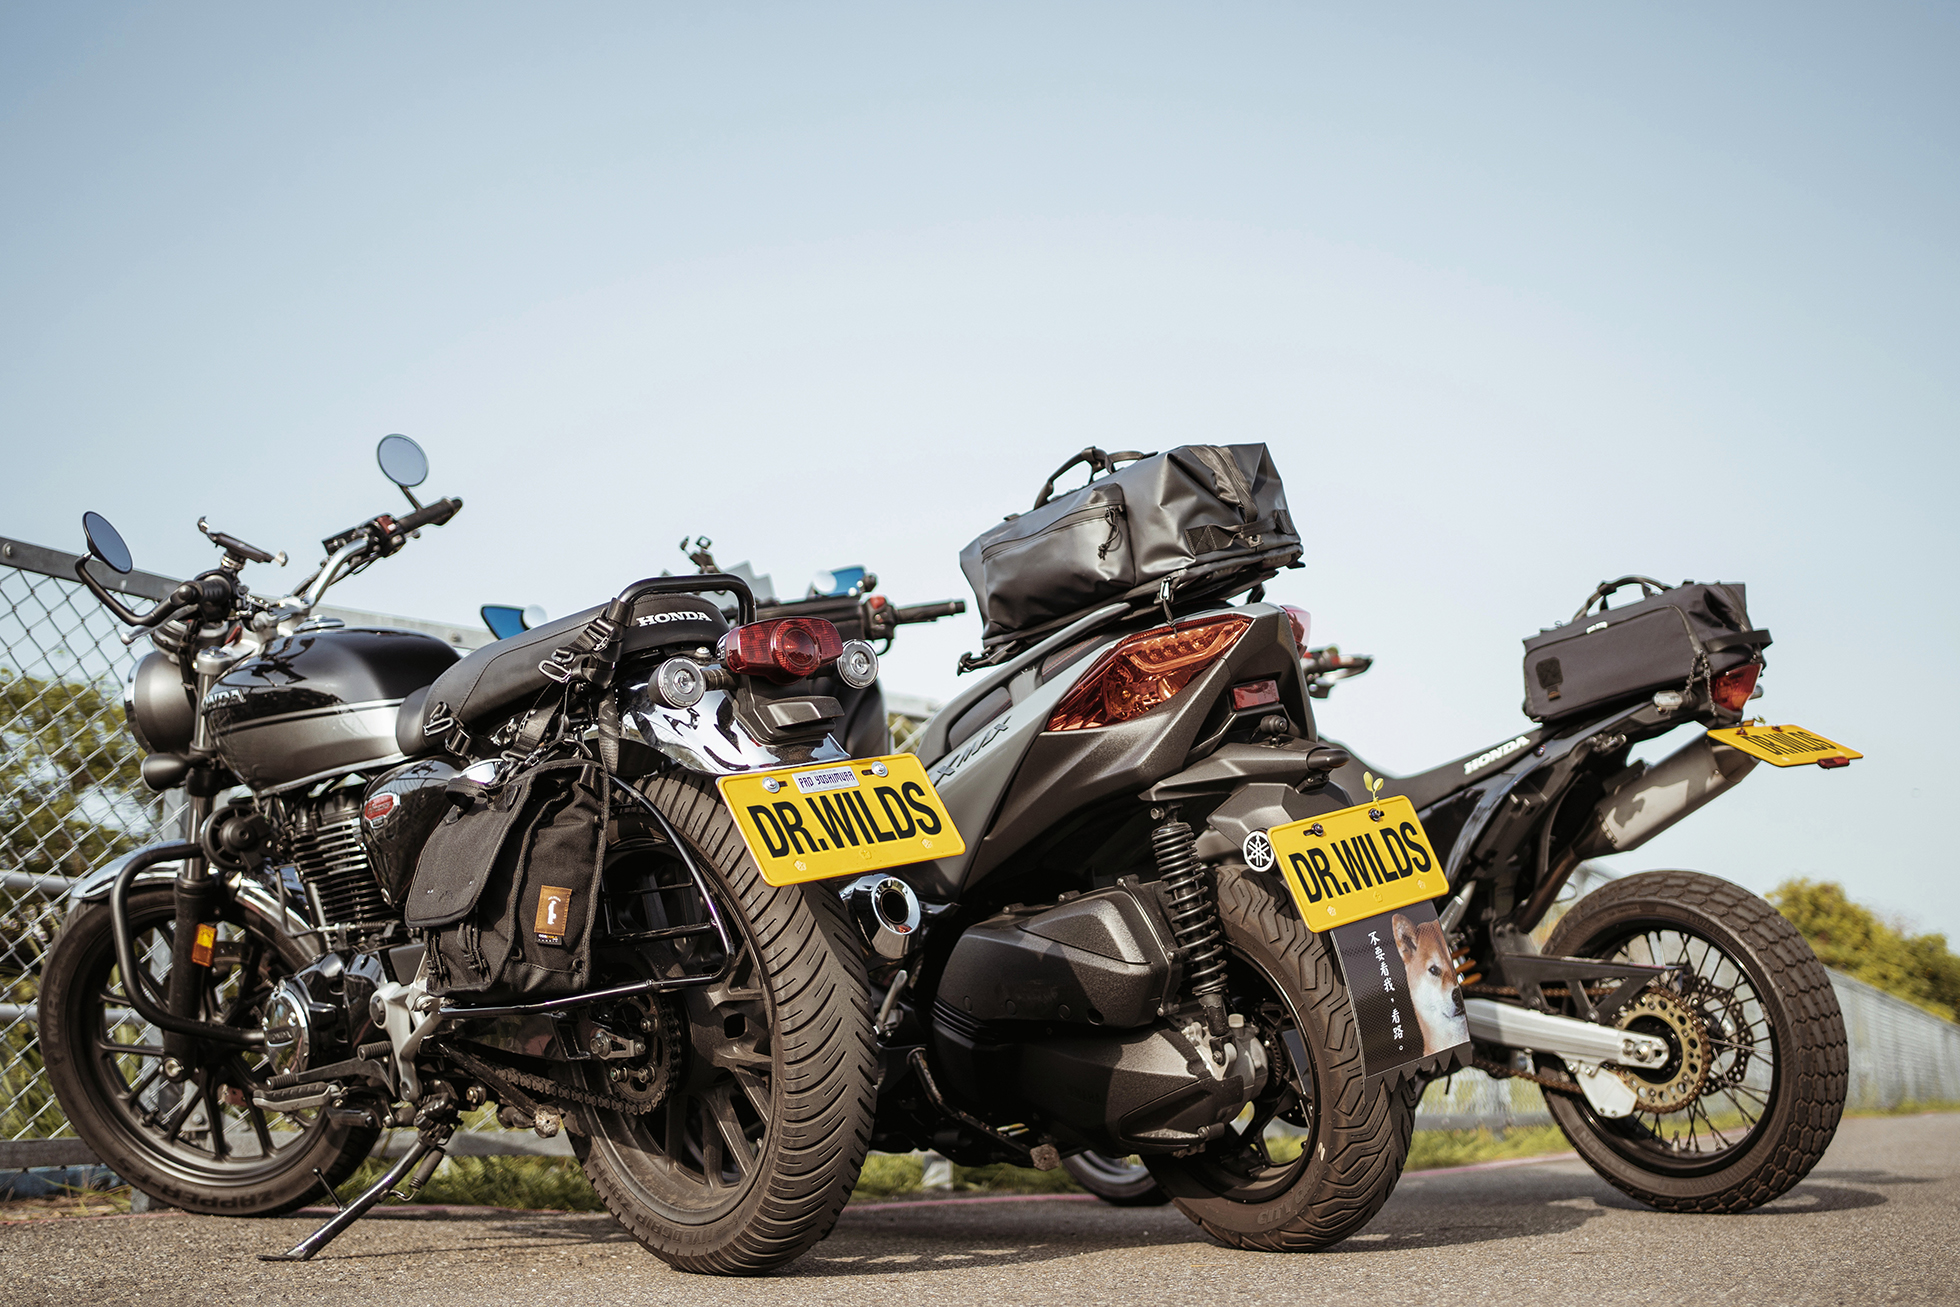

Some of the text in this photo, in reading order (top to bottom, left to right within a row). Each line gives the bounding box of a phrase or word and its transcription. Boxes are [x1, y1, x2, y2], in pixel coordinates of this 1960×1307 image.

[636, 611, 712, 627] HONDA
[201, 689, 247, 710] ONDA
[933, 715, 1012, 788] XMAX
[1463, 735, 1530, 775] HONDA
[814, 771, 856, 786] YOSHIMURA
[747, 781, 942, 859] DR.WILDS
[1288, 821, 1432, 904] DR.WILDS
[46, 969, 65, 1044] MRF
[1257, 1194, 1294, 1225] CITY
